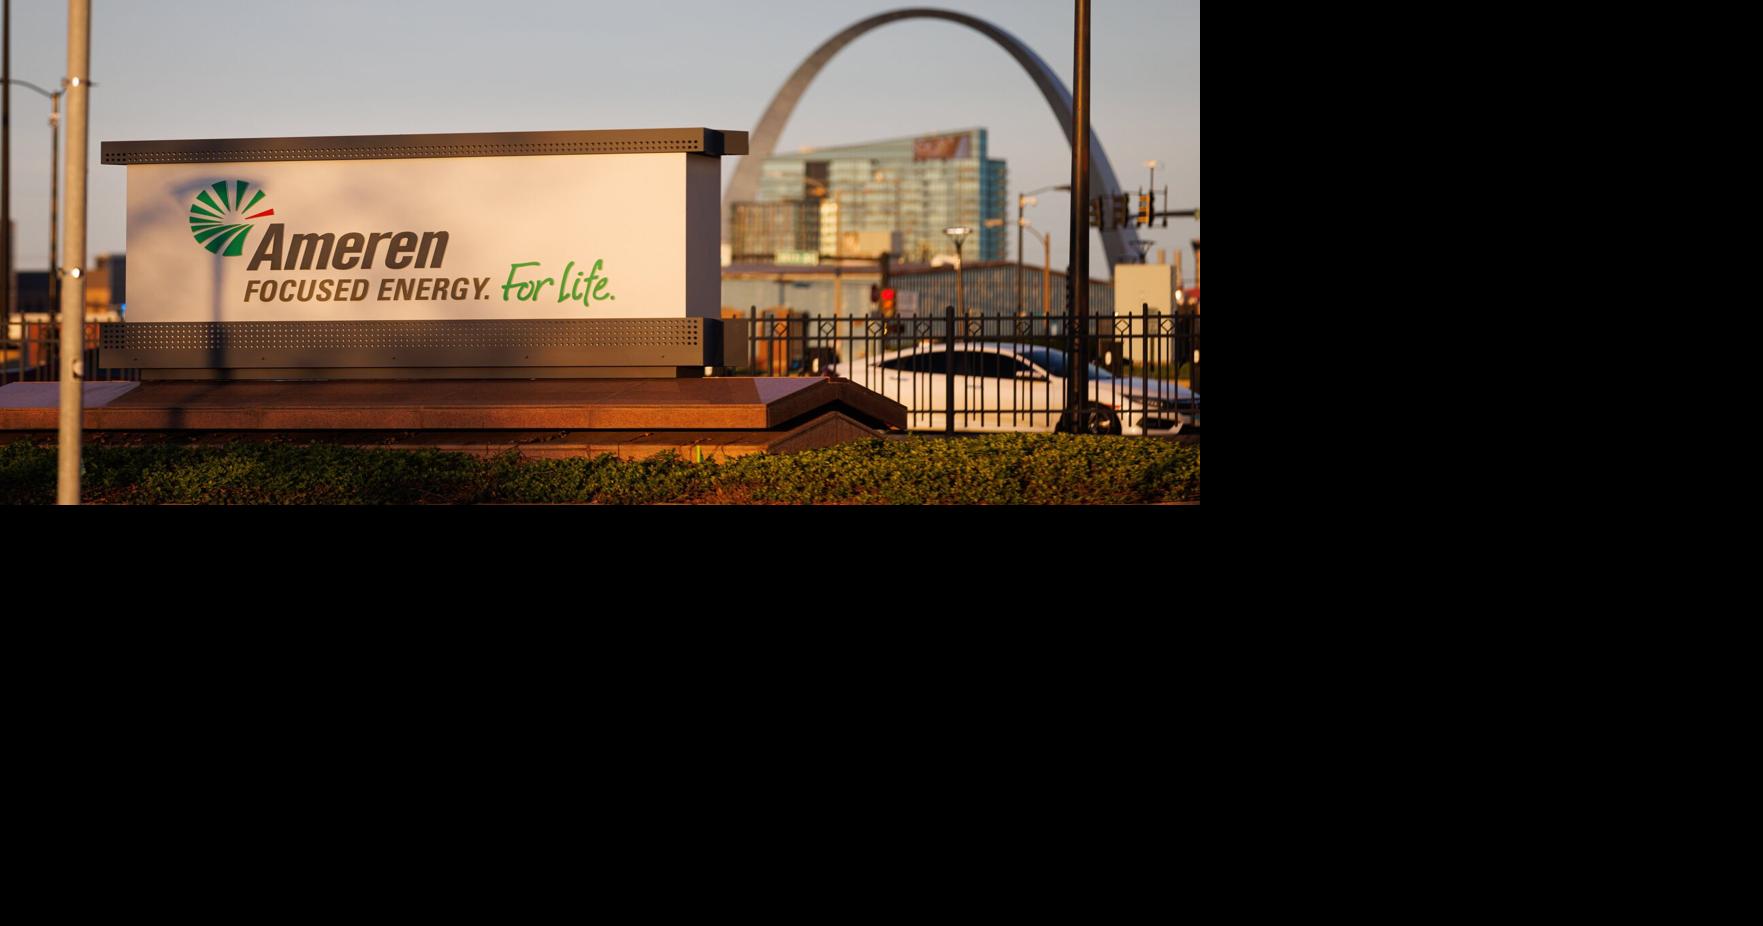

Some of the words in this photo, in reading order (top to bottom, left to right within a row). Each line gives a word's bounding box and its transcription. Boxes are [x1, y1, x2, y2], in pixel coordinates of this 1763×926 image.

[246, 223, 450, 271] Ameren
[244, 278, 370, 303] FOCUSED
[377, 277, 490, 302] ENERGY.
[501, 261, 554, 302] For
